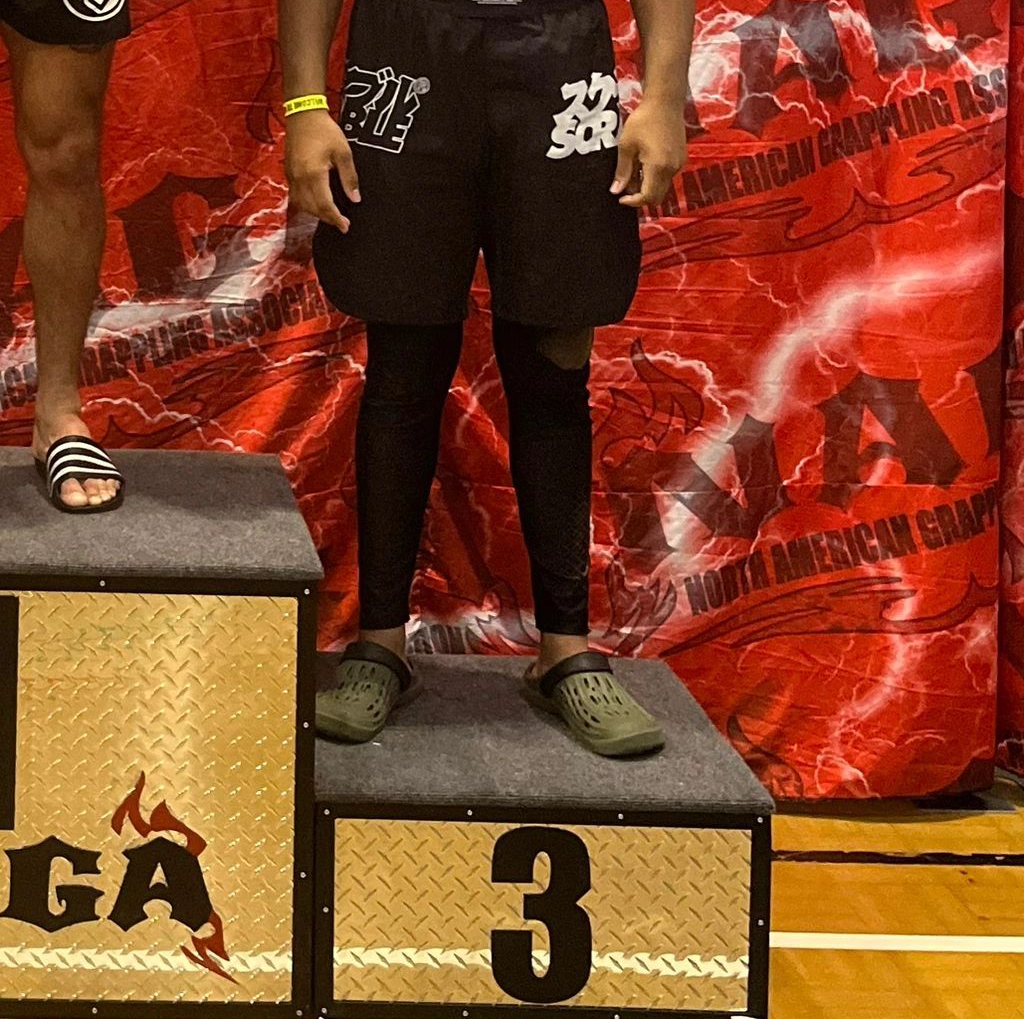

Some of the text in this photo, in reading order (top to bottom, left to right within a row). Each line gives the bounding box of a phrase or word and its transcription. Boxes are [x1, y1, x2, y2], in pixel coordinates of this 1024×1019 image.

[681, 135, 817, 211] AMERICAN
[817, 87, 957, 168] GRAPPLING
[81, 314, 210, 387] RAPPLING
[684, 549, 772, 616] NORTH
[771, 513, 918, 586] AMERICAN
[491, 826, 592, 1003] 3
